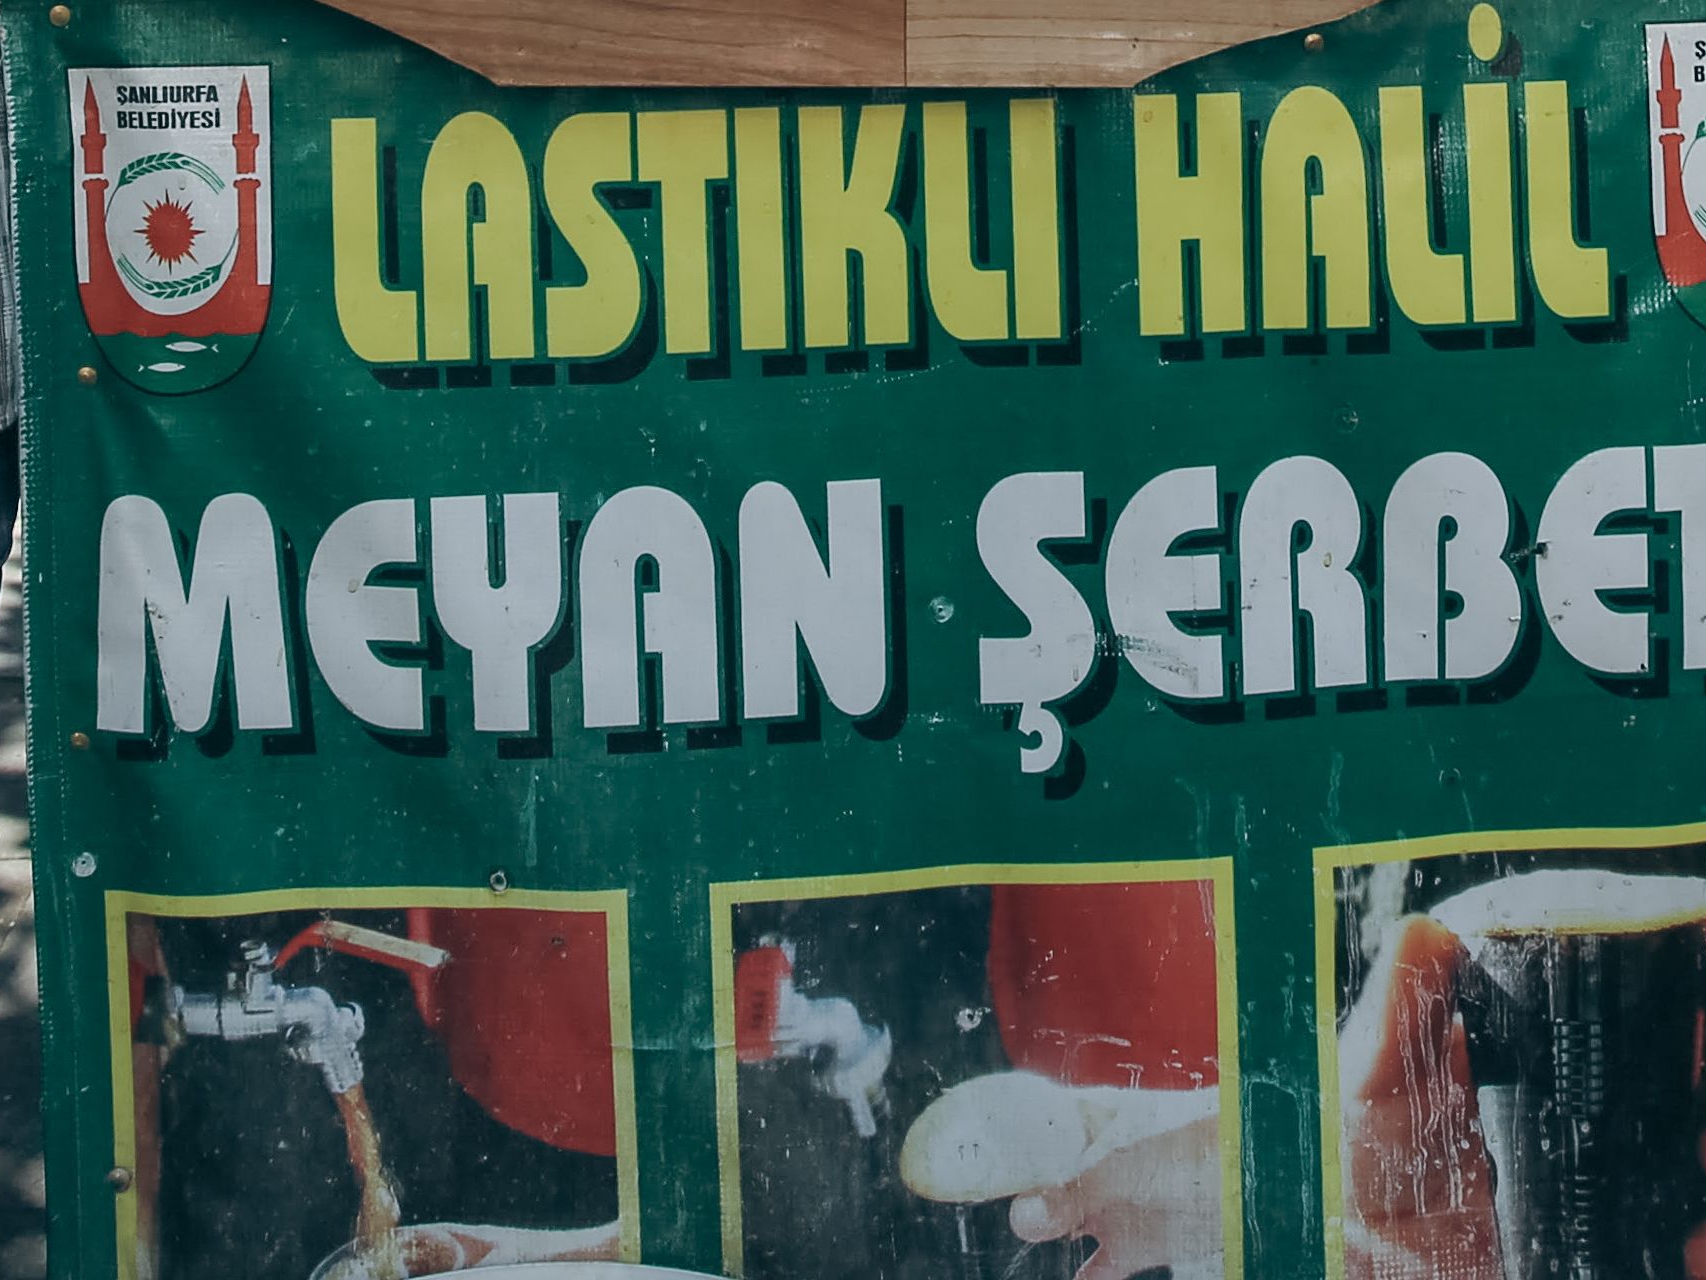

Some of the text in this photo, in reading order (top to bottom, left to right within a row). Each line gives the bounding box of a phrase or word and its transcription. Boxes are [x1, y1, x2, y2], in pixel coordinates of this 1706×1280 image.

[117, 85, 219, 106] ŞANLIURFA
[117, 109, 221, 130] BELEDİYESİ
[1135, 1, 1609, 337] HALİL
[97, 479, 886, 733] MEYAN
